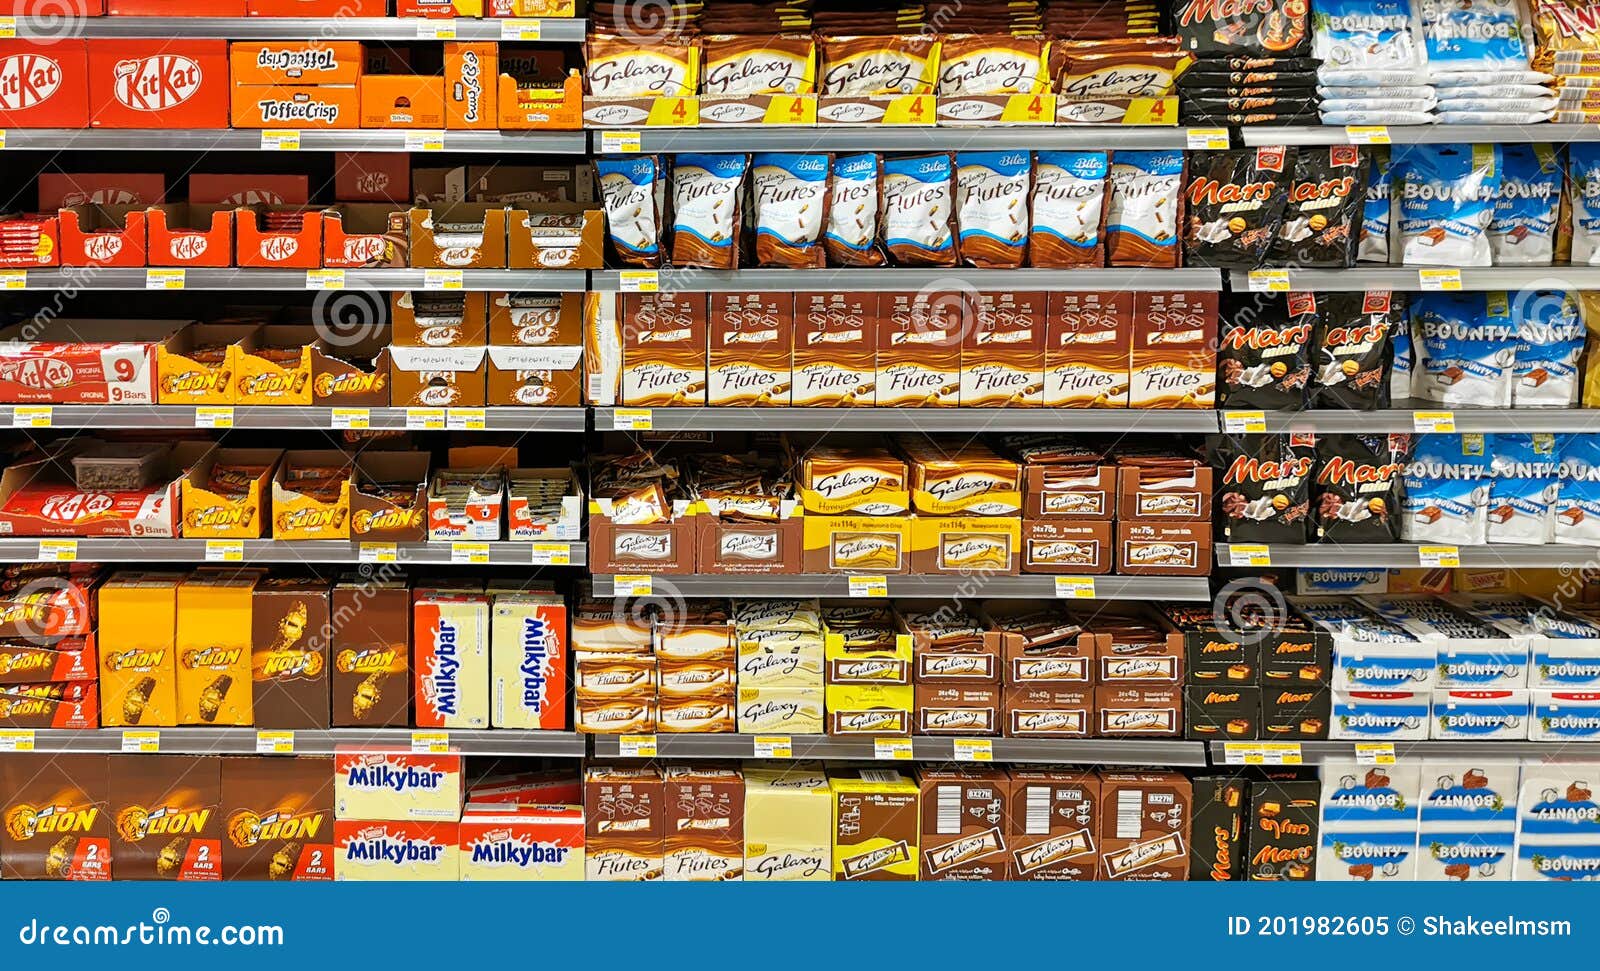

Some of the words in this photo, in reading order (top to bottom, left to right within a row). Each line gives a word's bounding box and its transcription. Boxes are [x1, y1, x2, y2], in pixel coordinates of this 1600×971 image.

[127, 56, 196, 110] KitKat
[591, 59, 673, 96] Galaxy
[707, 59, 793, 95] Galaxy
[824, 60, 911, 96] Galaxy
[940, 58, 1026, 94] Galaxy
[595, 104, 629, 119] Galaxy
[672, 98, 687, 119] 4
[712, 104, 746, 119] Galaxy
[789, 98, 804, 116] 4
[830, 104, 865, 118] Galaxy
[909, 96, 924, 116] 4
[950, 103, 984, 116] Galaxy
[1028, 98, 1042, 115] 4
[1070, 104, 1105, 117] Galaxy
[1150, 100, 1166, 116] 4
[605, 188, 645, 211] Flutes
[677, 181, 733, 201] Flutes
[1184, 177, 1275, 205] Mars
[90, 237, 120, 257] KitKat
[176, 236, 205, 257] KitKat
[266, 237, 296, 260] KitKat
[350, 238, 380, 261] KitKat
[1221, 324, 1312, 349] Mars
[114, 358, 135, 382] 9
[179, 371, 220, 392] LION
[257, 372, 295, 392] LION
[335, 372, 373, 392] LION
[638, 371, 691, 389] Flutes
[723, 373, 776, 390] Flutes
[807, 372, 861, 390] Flutes
[891, 373, 945, 390] Flutes
[975, 373, 1030, 390] Flutes
[1059, 373, 1115, 390] Flutes
[1146, 373, 1202, 390] Flutes
[112, 388, 122, 400] 9
[124, 391, 146, 399] Bars
[1223, 455, 1311, 484] Mars
[1318, 456, 1404, 484] Mar
[817, 472, 880, 497] Galaxy
[929, 477, 993, 500] Galaxy
[49, 493, 108, 520] KitKat
[201, 506, 242, 526] LION
[294, 509, 335, 527] LION
[372, 509, 414, 529] LION
[133, 524, 145, 535] 9
[620, 535, 658, 552] Galaxy
[726, 535, 764, 552] Galaxy
[839, 542, 883, 558] Galaxy
[948, 542, 992, 558] Galaxy
[1313, 572, 1361, 583] BOUNTY
[67, 609, 73, 620] 2
[1203, 641, 1240, 653] Mars
[1276, 641, 1313, 654] Mars
[73, 656, 81, 667] 2
[122, 650, 165, 668] LION
[201, 649, 243, 666] LION
[354, 650, 396, 667] LION
[521, 618, 546, 713] Milkybar
[745, 655, 798, 676] Galaxy
[933, 657, 977, 672] Galaxy
[434, 620, 460, 715] Milkybar
[848, 662, 895, 679] Galaxy
[1026, 661, 1072, 677] Galaxy
[1115, 661, 1160, 675] Galaxy
[1356, 668, 1409, 680] BOUNTY
[1450, 664, 1502, 676] BOUNTY
[73, 686, 81, 697] 2
[1204, 691, 1240, 704] Mars
[1276, 691, 1313, 704] Mars
[74, 704, 81, 715] 2
[744, 701, 798, 722] Galaxy
[850, 712, 895, 728] Galaxy
[934, 712, 978, 727] Galaxy
[1025, 713, 1069, 730] Galaxy
[1113, 712, 1159, 726] Galaxy
[1348, 715, 1403, 727] BOUNTY
[1450, 715, 1503, 727] BOUNTY
[349, 766, 442, 791] Milkybar
[37, 808, 98, 832] LION
[148, 809, 209, 834] LION
[259, 814, 323, 840] LION
[86, 845, 97, 861] 2
[198, 846, 209, 861] 2
[311, 851, 322, 867] 2
[347, 840, 442, 864] Milkybar
[472, 842, 568, 867] Milkybar
[1252, 844, 1313, 865] Mars
[1343, 845, 1401, 858] BOUNTY
[1439, 845, 1500, 858] BOUNTY
[599, 859, 649, 875] Flutes
[677, 858, 729, 874] Flutes
[757, 855, 822, 878] Galaxy
